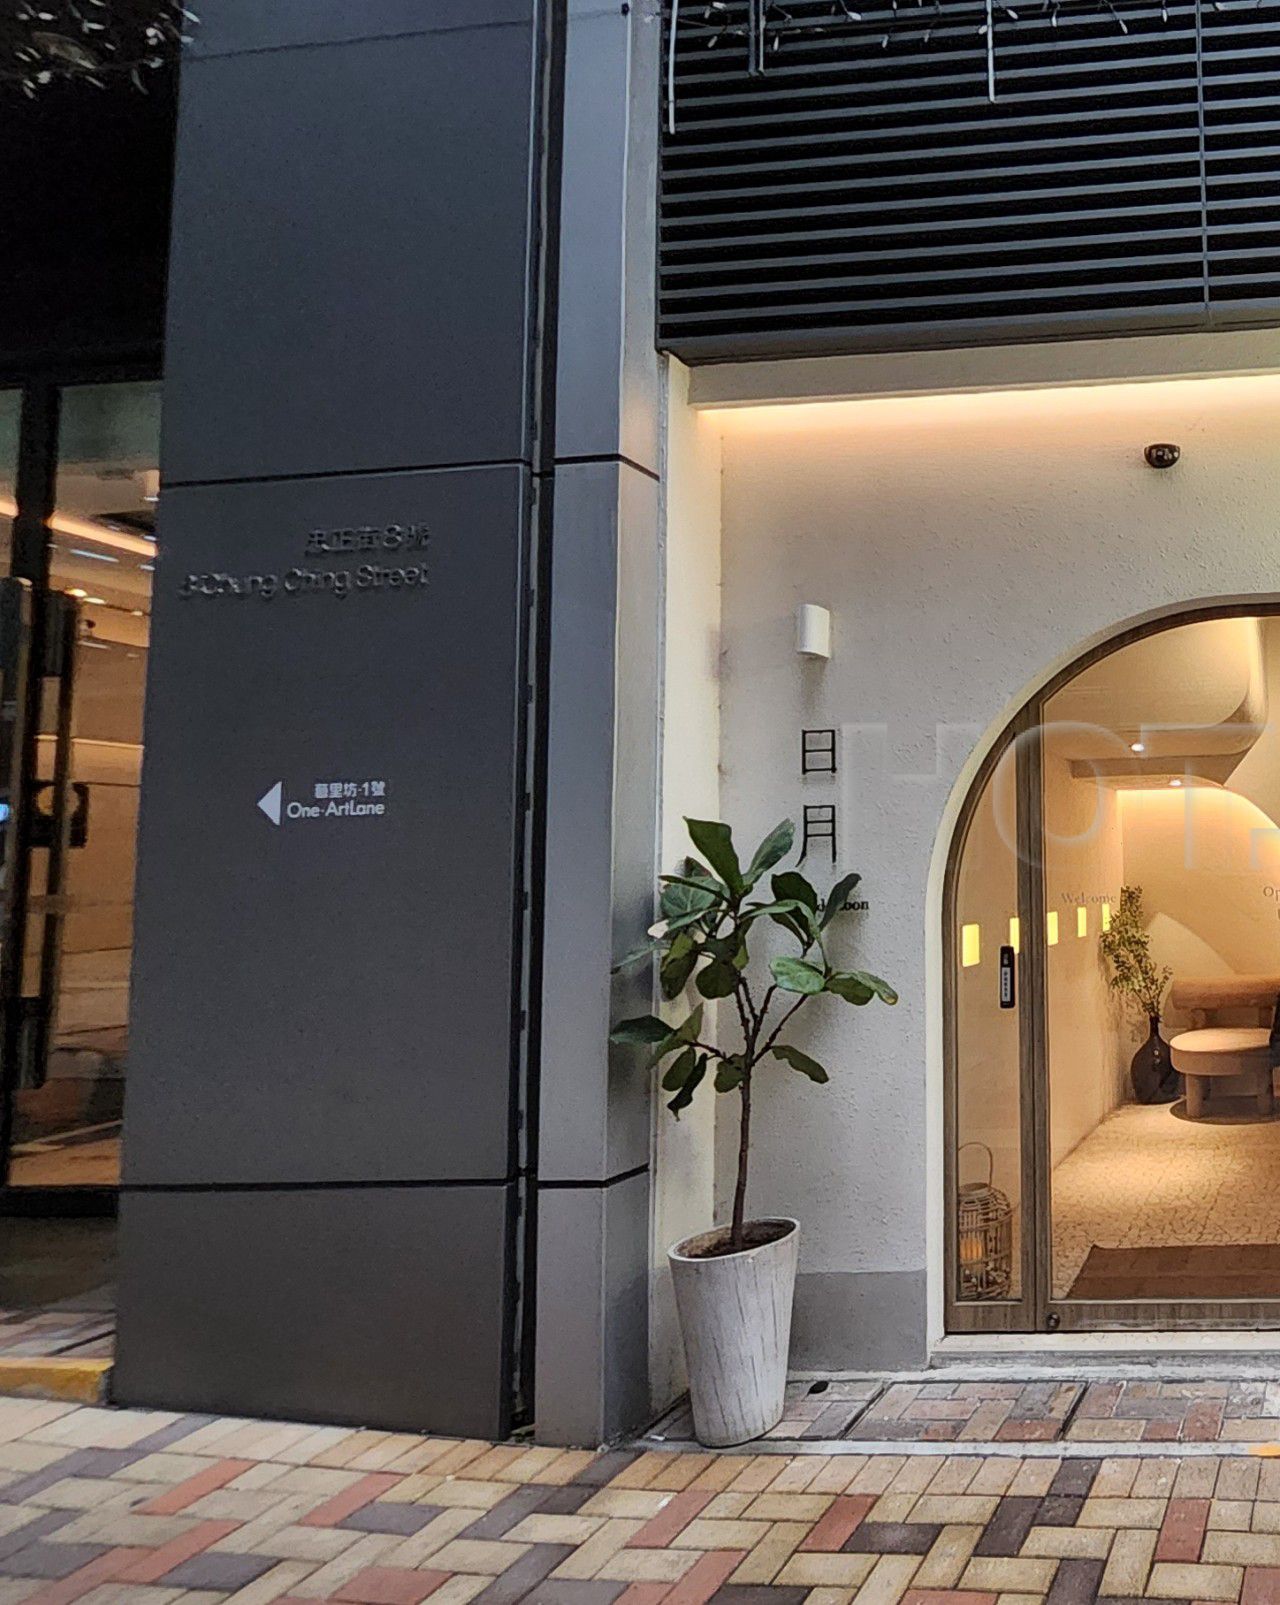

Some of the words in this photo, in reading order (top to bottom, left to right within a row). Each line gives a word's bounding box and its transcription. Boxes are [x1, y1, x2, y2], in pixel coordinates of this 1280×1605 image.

[284, 566, 351, 597] Ching
[356, 562, 430, 587] Street
[795, 729, 836, 868] 日月
[842, 899, 869, 911] oon
[1061, 892, 1117, 903] Welcome
